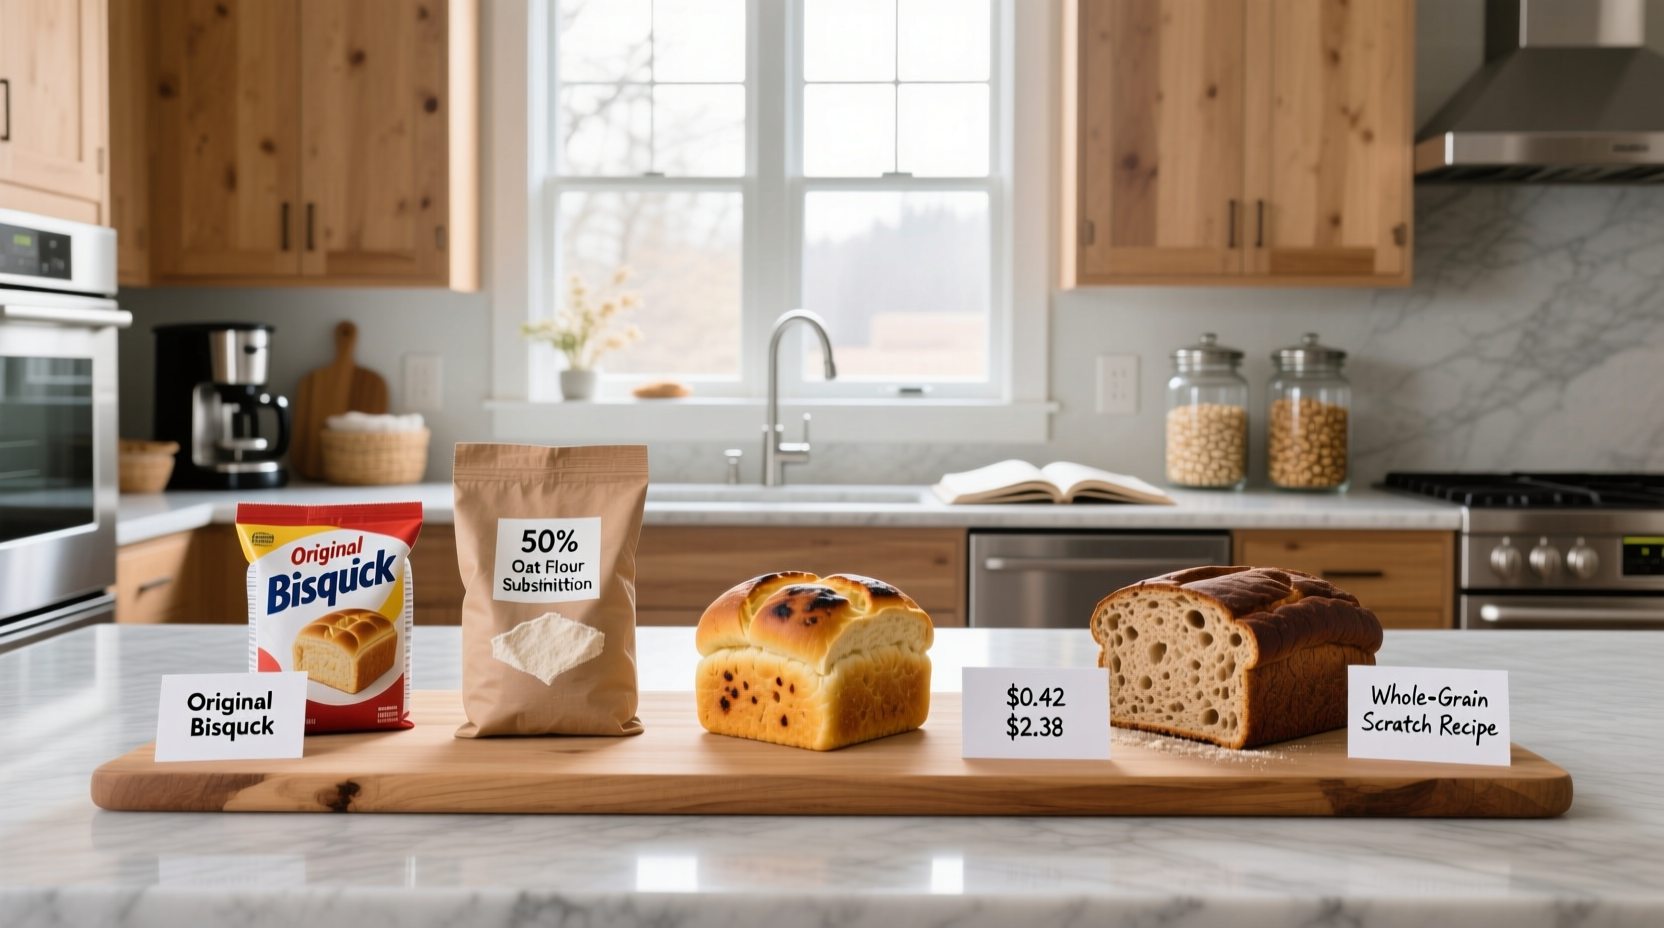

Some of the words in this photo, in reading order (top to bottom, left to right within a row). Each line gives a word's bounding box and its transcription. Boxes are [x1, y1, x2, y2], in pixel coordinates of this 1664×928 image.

[290, 535, 364, 566] Original
[521, 528, 579, 553] 50%
[511, 559, 541, 574] Oat
[545, 559, 586, 574] Flour
[266, 548, 396, 616] Bisquick
[187, 690, 273, 716] Original
[1006, 682, 1067, 711] $0.42
[1371, 682, 1489, 708] Whole-Grain
[190, 715, 275, 742] Bisquck
[1006, 712, 1064, 742] $2.38
[1361, 711, 1432, 734] Scratch
[1439, 714, 1499, 746] Recipe
